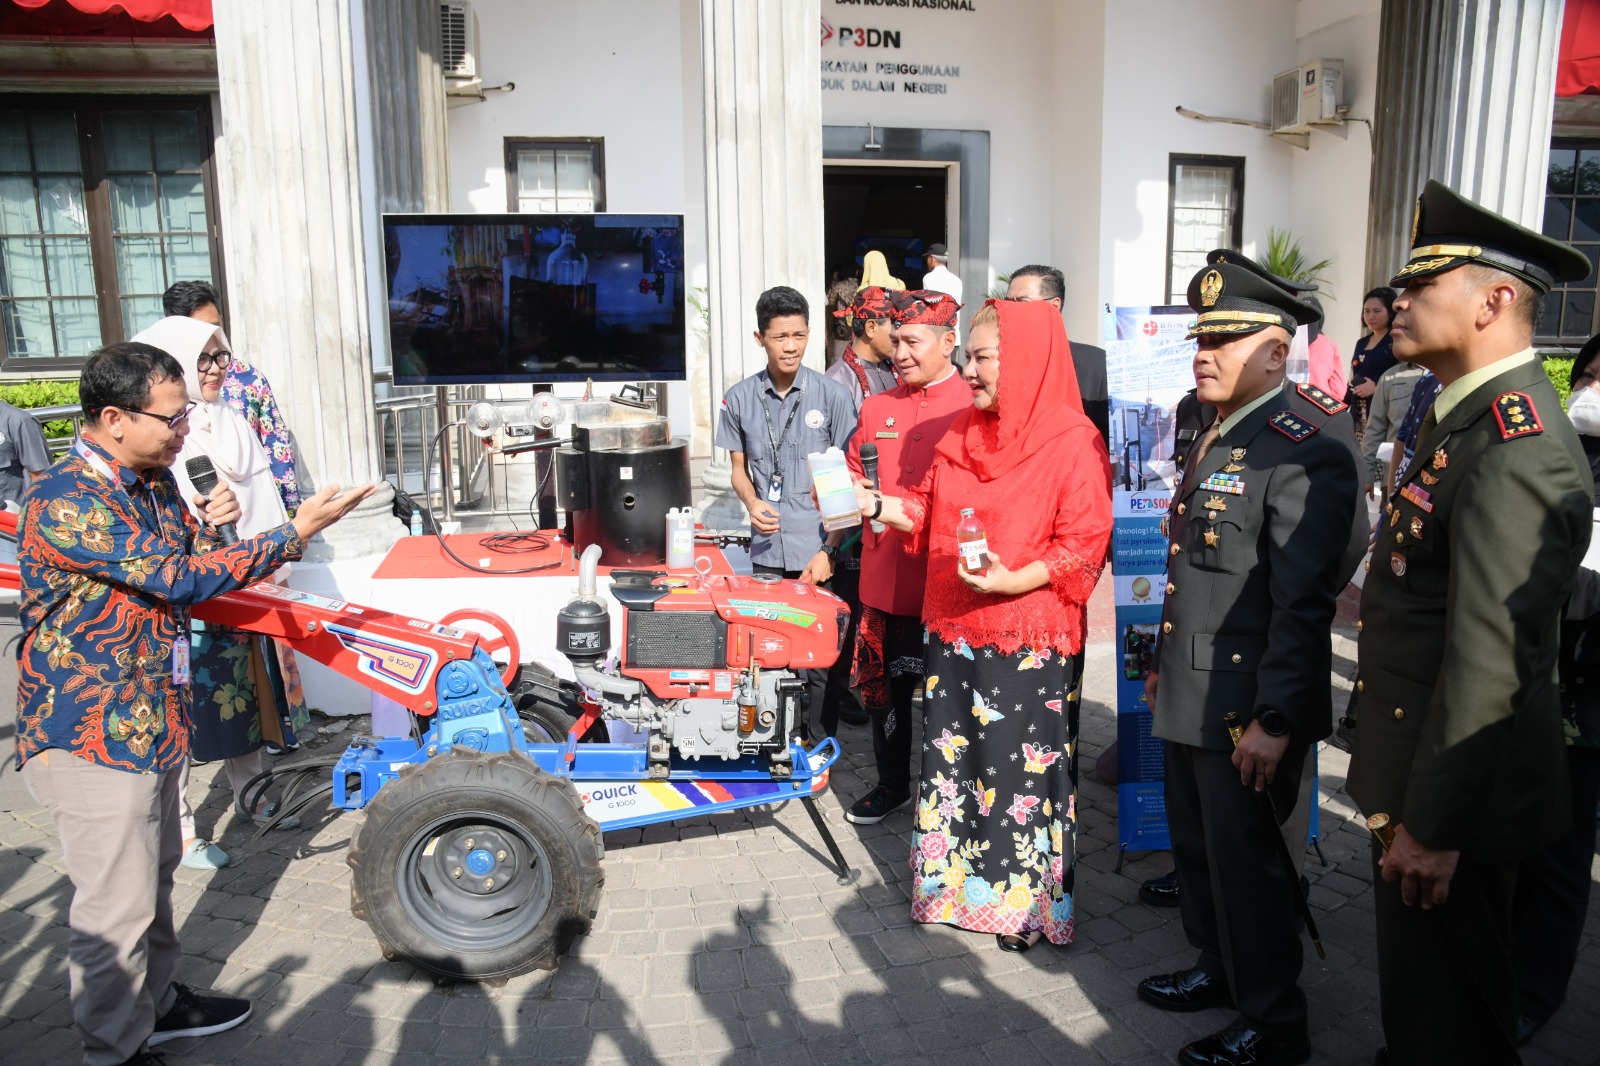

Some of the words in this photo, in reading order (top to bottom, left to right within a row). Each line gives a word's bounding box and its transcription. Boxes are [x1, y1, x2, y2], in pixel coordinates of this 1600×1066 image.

[912, 0, 976, 11] NASIONAL
[839, 27, 901, 48] P3DN
[876, 62, 960, 77] PENGGUNAAN
[852, 80, 894, 92] DALAM
[904, 82, 947, 94] NEGERI
[1116, 527, 1149, 536] Teknologi
[1117, 548, 1143, 556] menjadi
[1145, 548, 1167, 556] energi
[388, 655, 395, 663] G
[396, 658, 415, 670] 1000
[592, 784, 637, 801] QUICK
[616, 799, 636, 807] 1000
